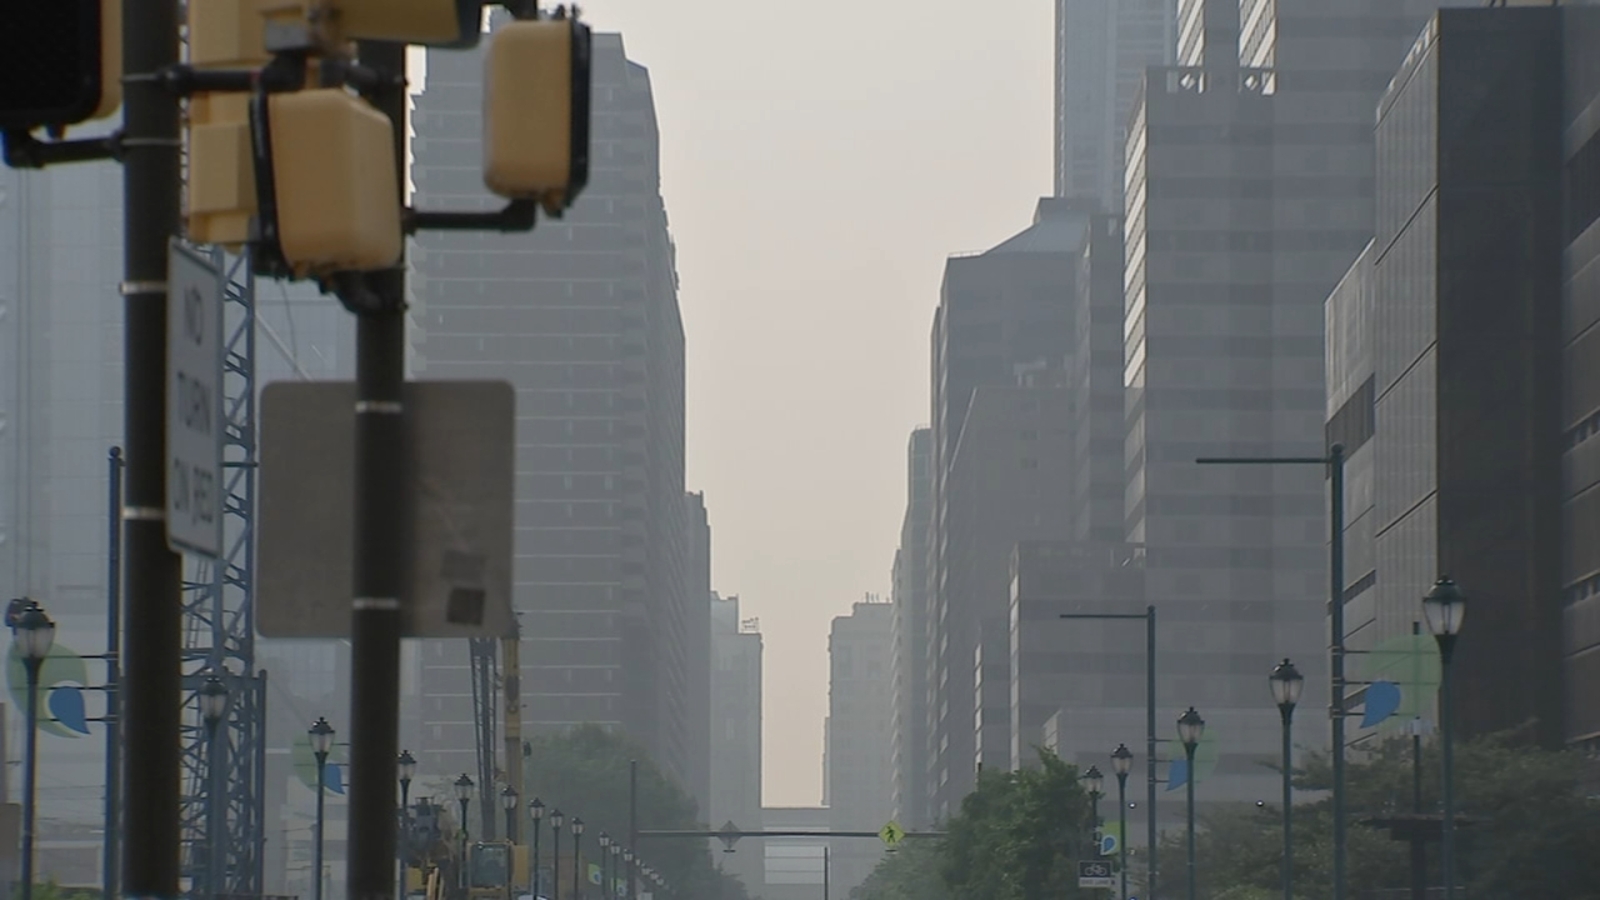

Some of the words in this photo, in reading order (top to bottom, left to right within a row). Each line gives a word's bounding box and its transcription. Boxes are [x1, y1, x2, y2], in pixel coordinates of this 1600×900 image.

[184, 285, 204, 346] NO
[177, 370, 211, 436] TURN
[174, 457, 190, 514] ON
[193, 464, 213, 526] RED
